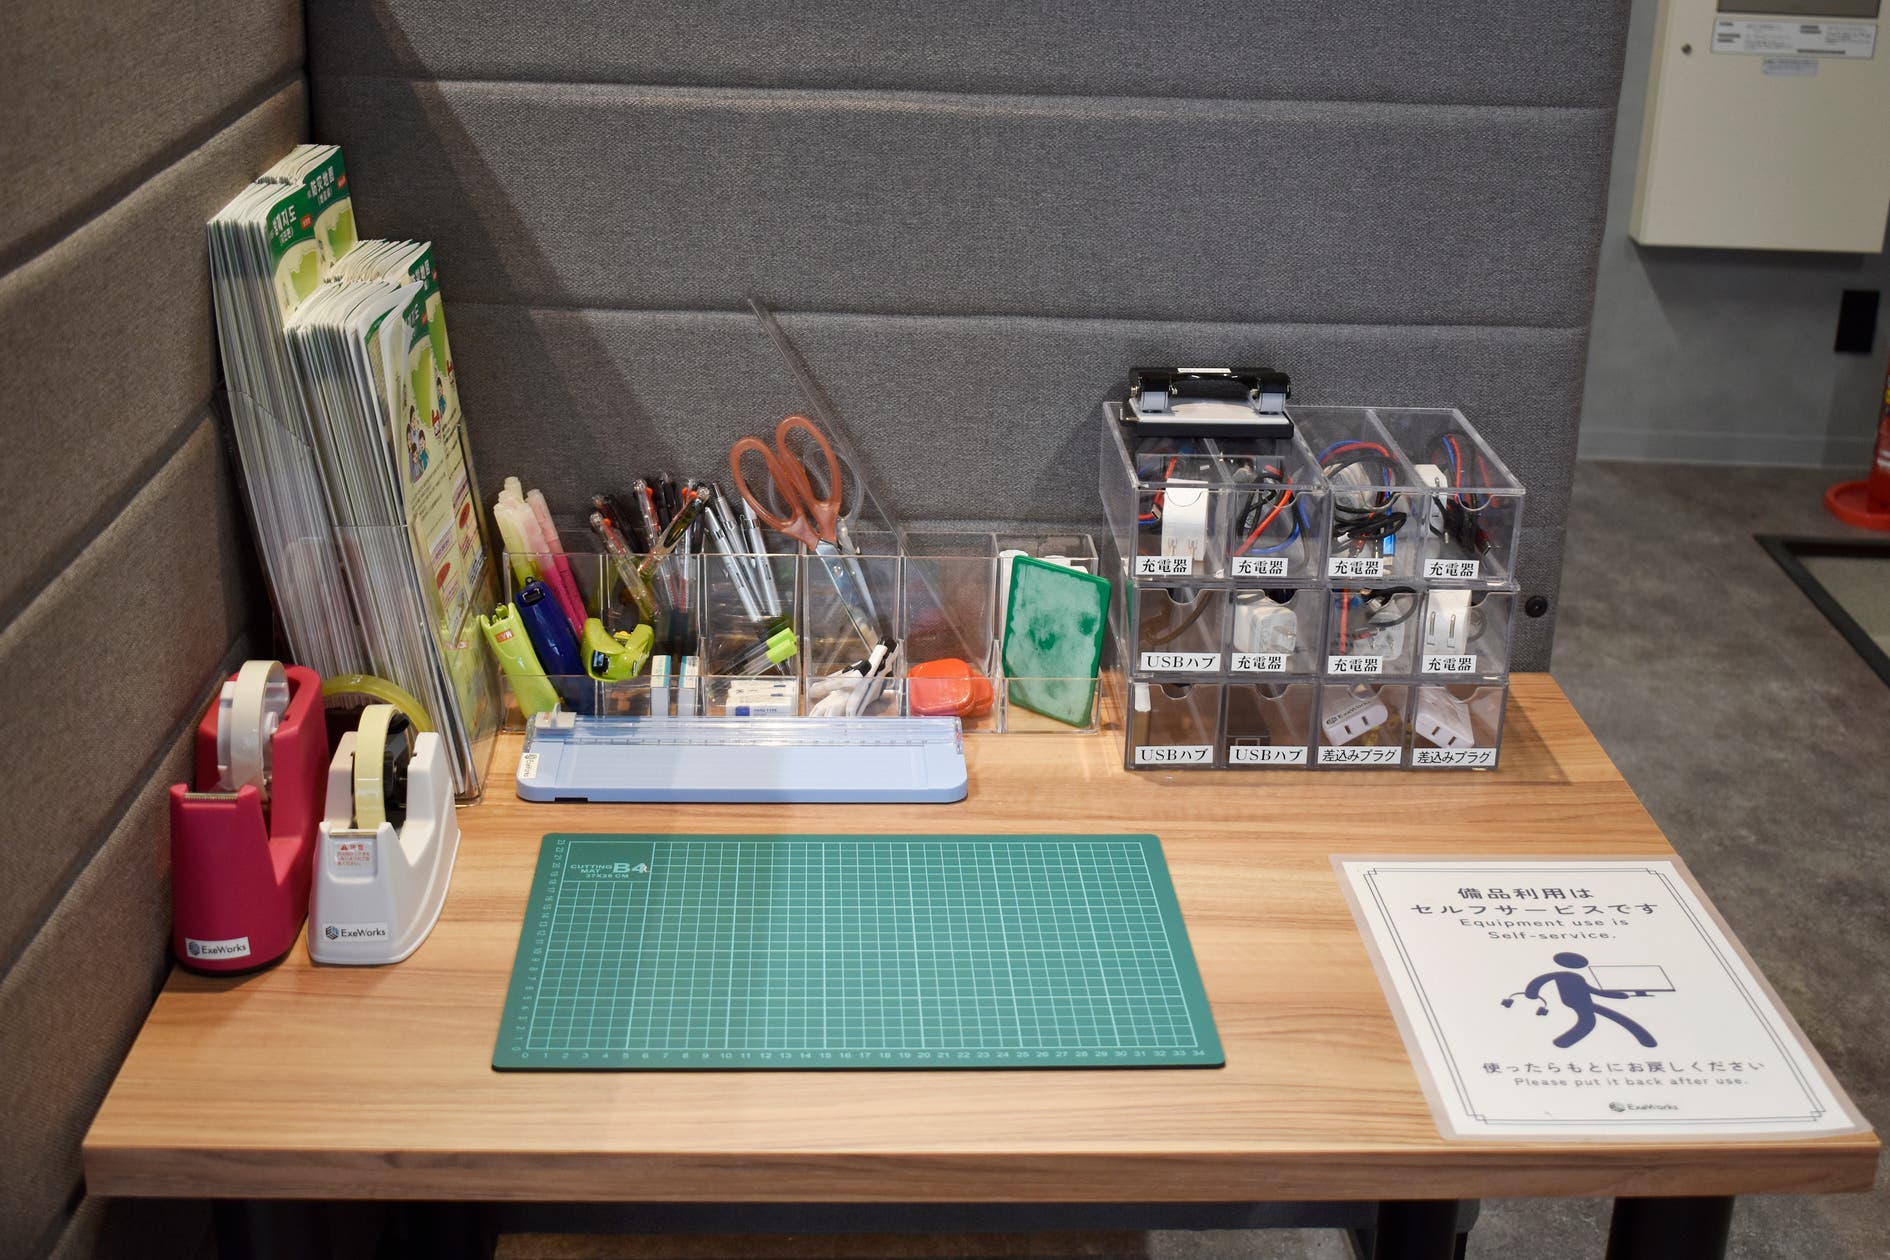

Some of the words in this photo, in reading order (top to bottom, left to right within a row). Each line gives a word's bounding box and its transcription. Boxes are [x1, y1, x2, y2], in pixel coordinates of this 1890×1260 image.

[1140, 559, 1188, 573] 充電器
[1237, 560, 1284, 574] 充電器
[1334, 561, 1380, 575] 充電器
[1428, 563, 1474, 577] 充電器
[1147, 656, 1216, 669] USBハブ
[1237, 656, 1282, 670] 充電器
[1333, 658, 1379, 672] 充電器
[1428, 657, 1473, 671] 充電器
[1140, 749, 1208, 761] USBハブ
[1235, 749, 1303, 762] USBハブ
[1323, 749, 1397, 763] 差込みプラグ
[1417, 751, 1491, 764] 差込みプラグ
[613, 862, 648, 874] B4
[1457, 887, 1595, 900] 備品利用は
[1410, 903, 1659, 916] セルフサービスです
[1460, 918, 1564, 929] Equipment
[1612, 918, 1629, 926] is
[340, 926, 386, 938] ExeWorks
[1488, 931, 1617, 940] Self-service.
[201, 943, 247, 957] ExeWorks
[1482, 1061, 1765, 1074] 使ったらもとにお戻しください
[1514, 1077, 1567, 1087] Please
[1574, 1077, 1600, 1089] put
[1606, 1076, 1620, 1085] it
[1625, 1076, 1661, 1086] back
[1669, 1076, 1708, 1086] after
[1716, 1078, 1748, 1086] use.
